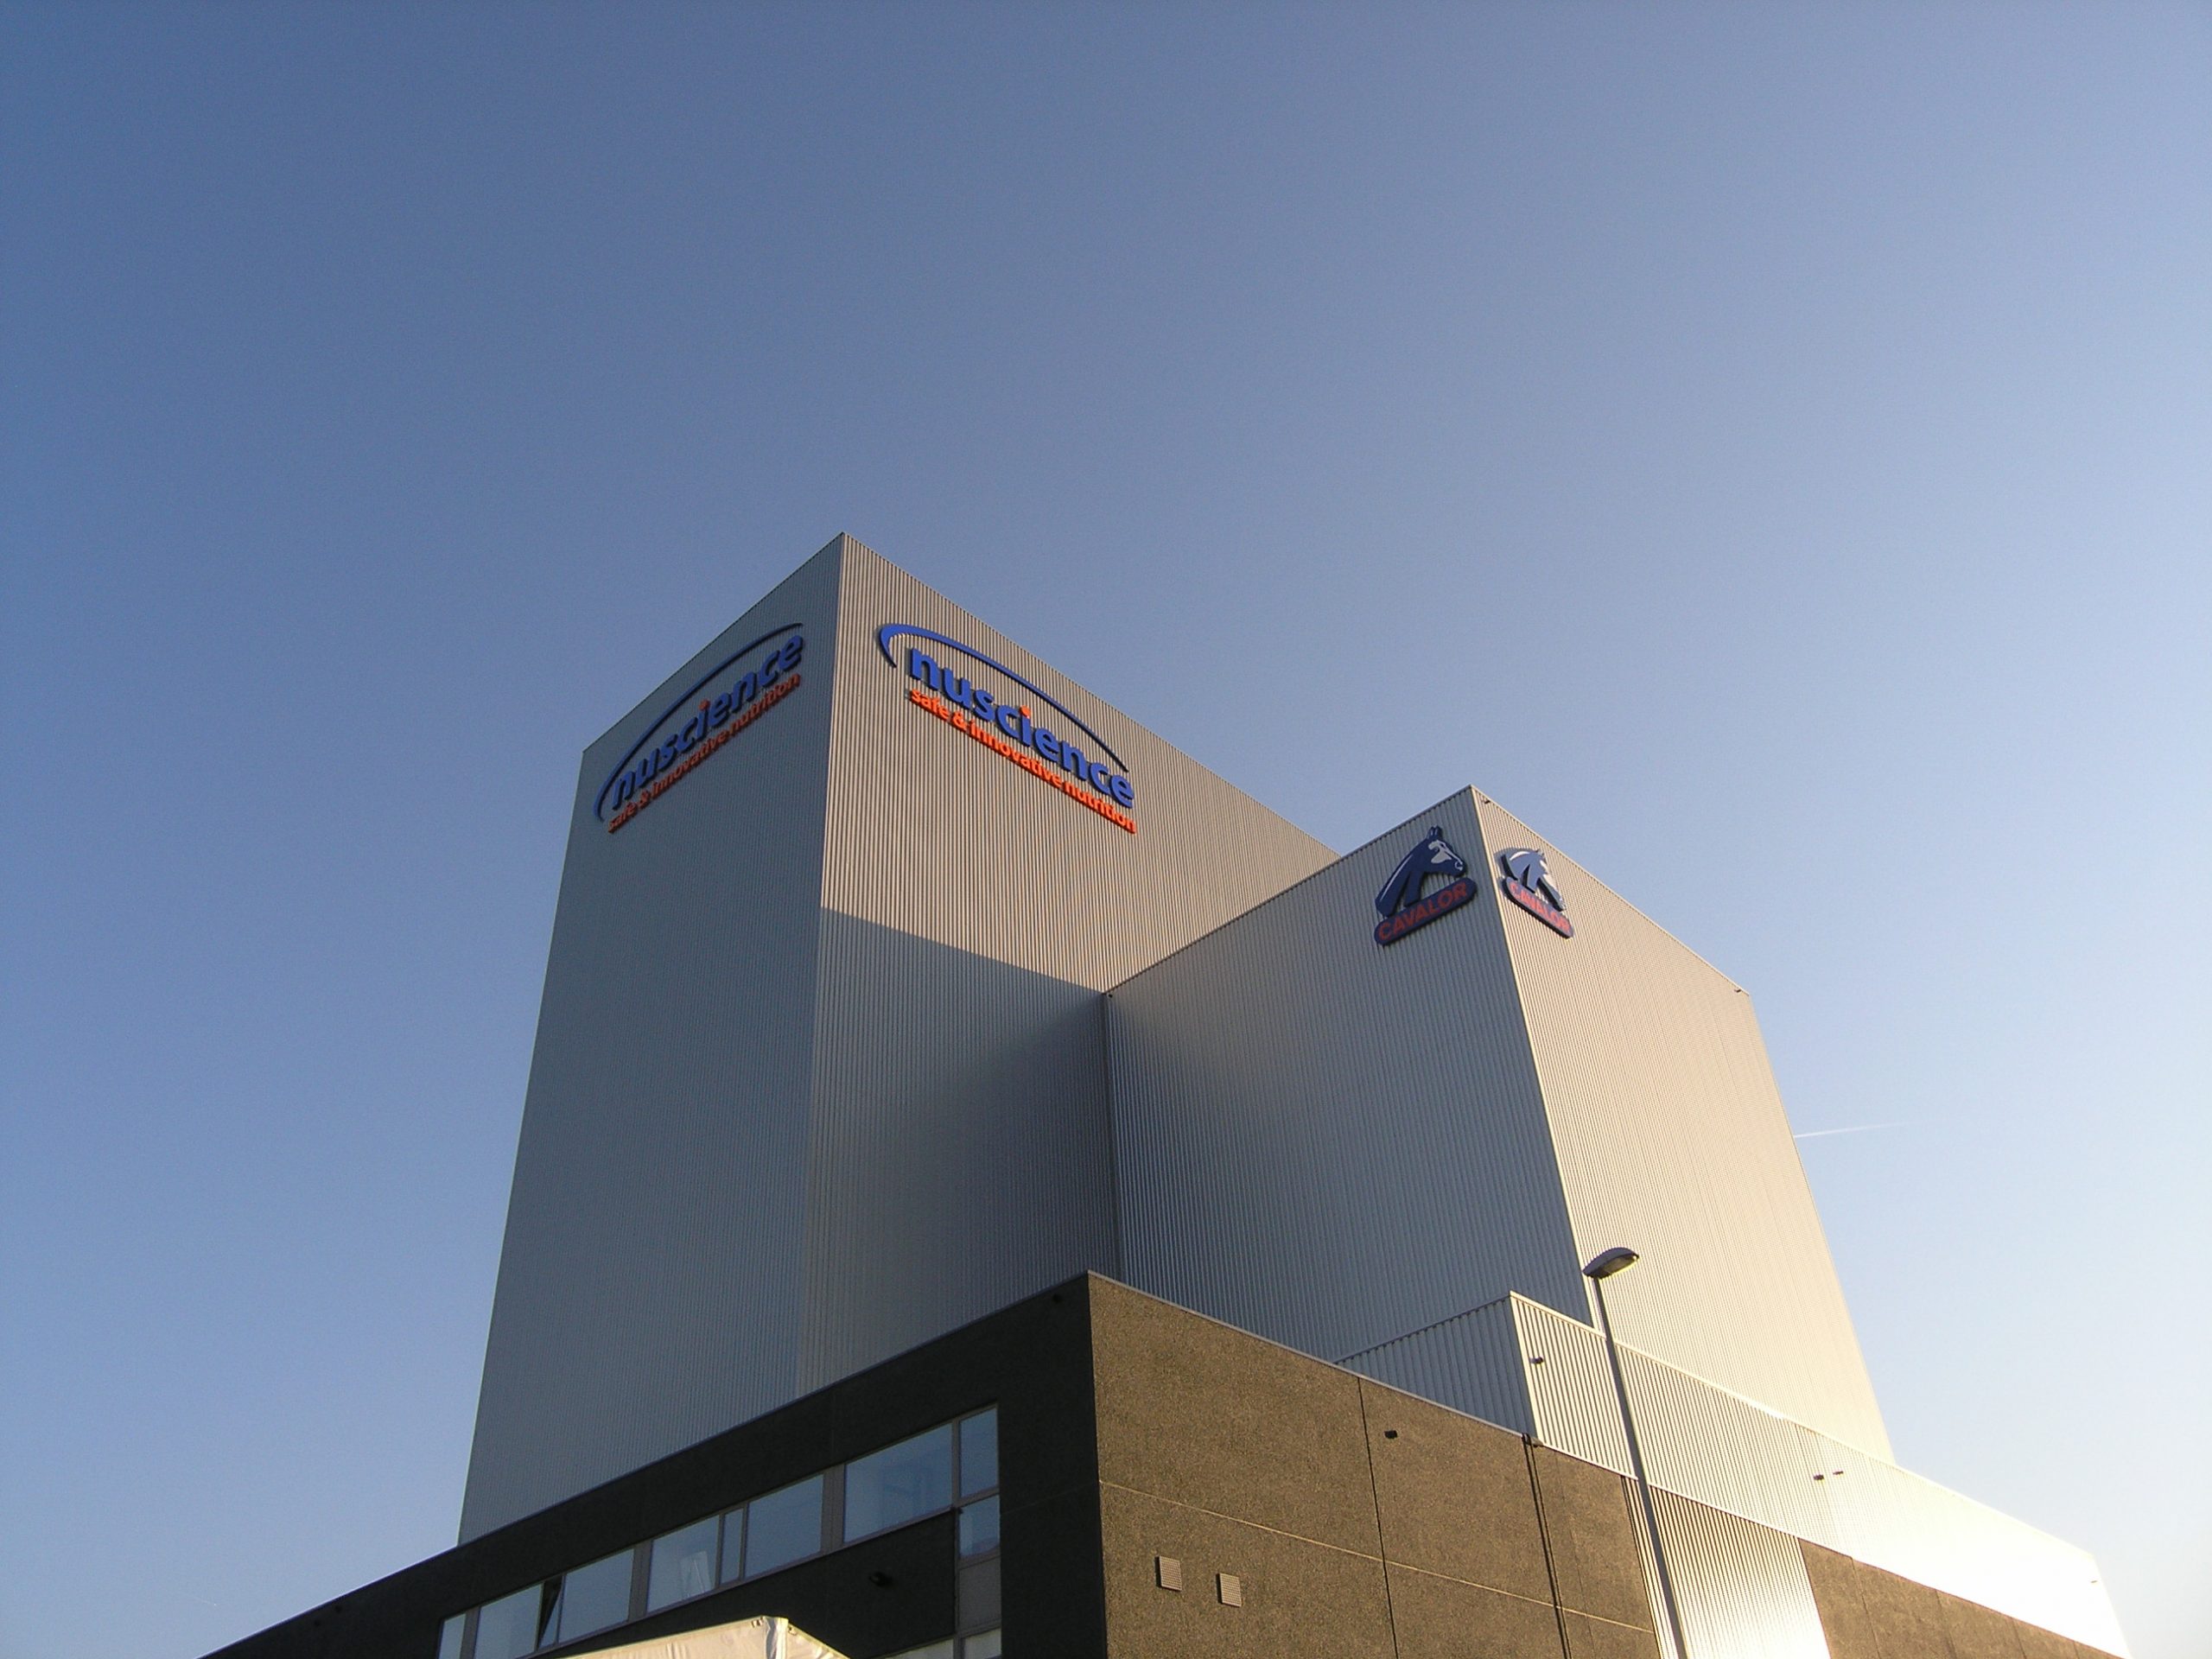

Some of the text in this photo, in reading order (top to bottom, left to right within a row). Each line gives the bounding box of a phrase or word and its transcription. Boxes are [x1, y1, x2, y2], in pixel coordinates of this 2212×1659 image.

[608, 672, 801, 834] safe & innovative nutrition
[611, 634, 804, 810] nuscience
[910, 647, 1135, 809] nuscience
[910, 689, 1136, 835] safe & innovative nutrition
[1378, 881, 1467, 940] CAVALOR
